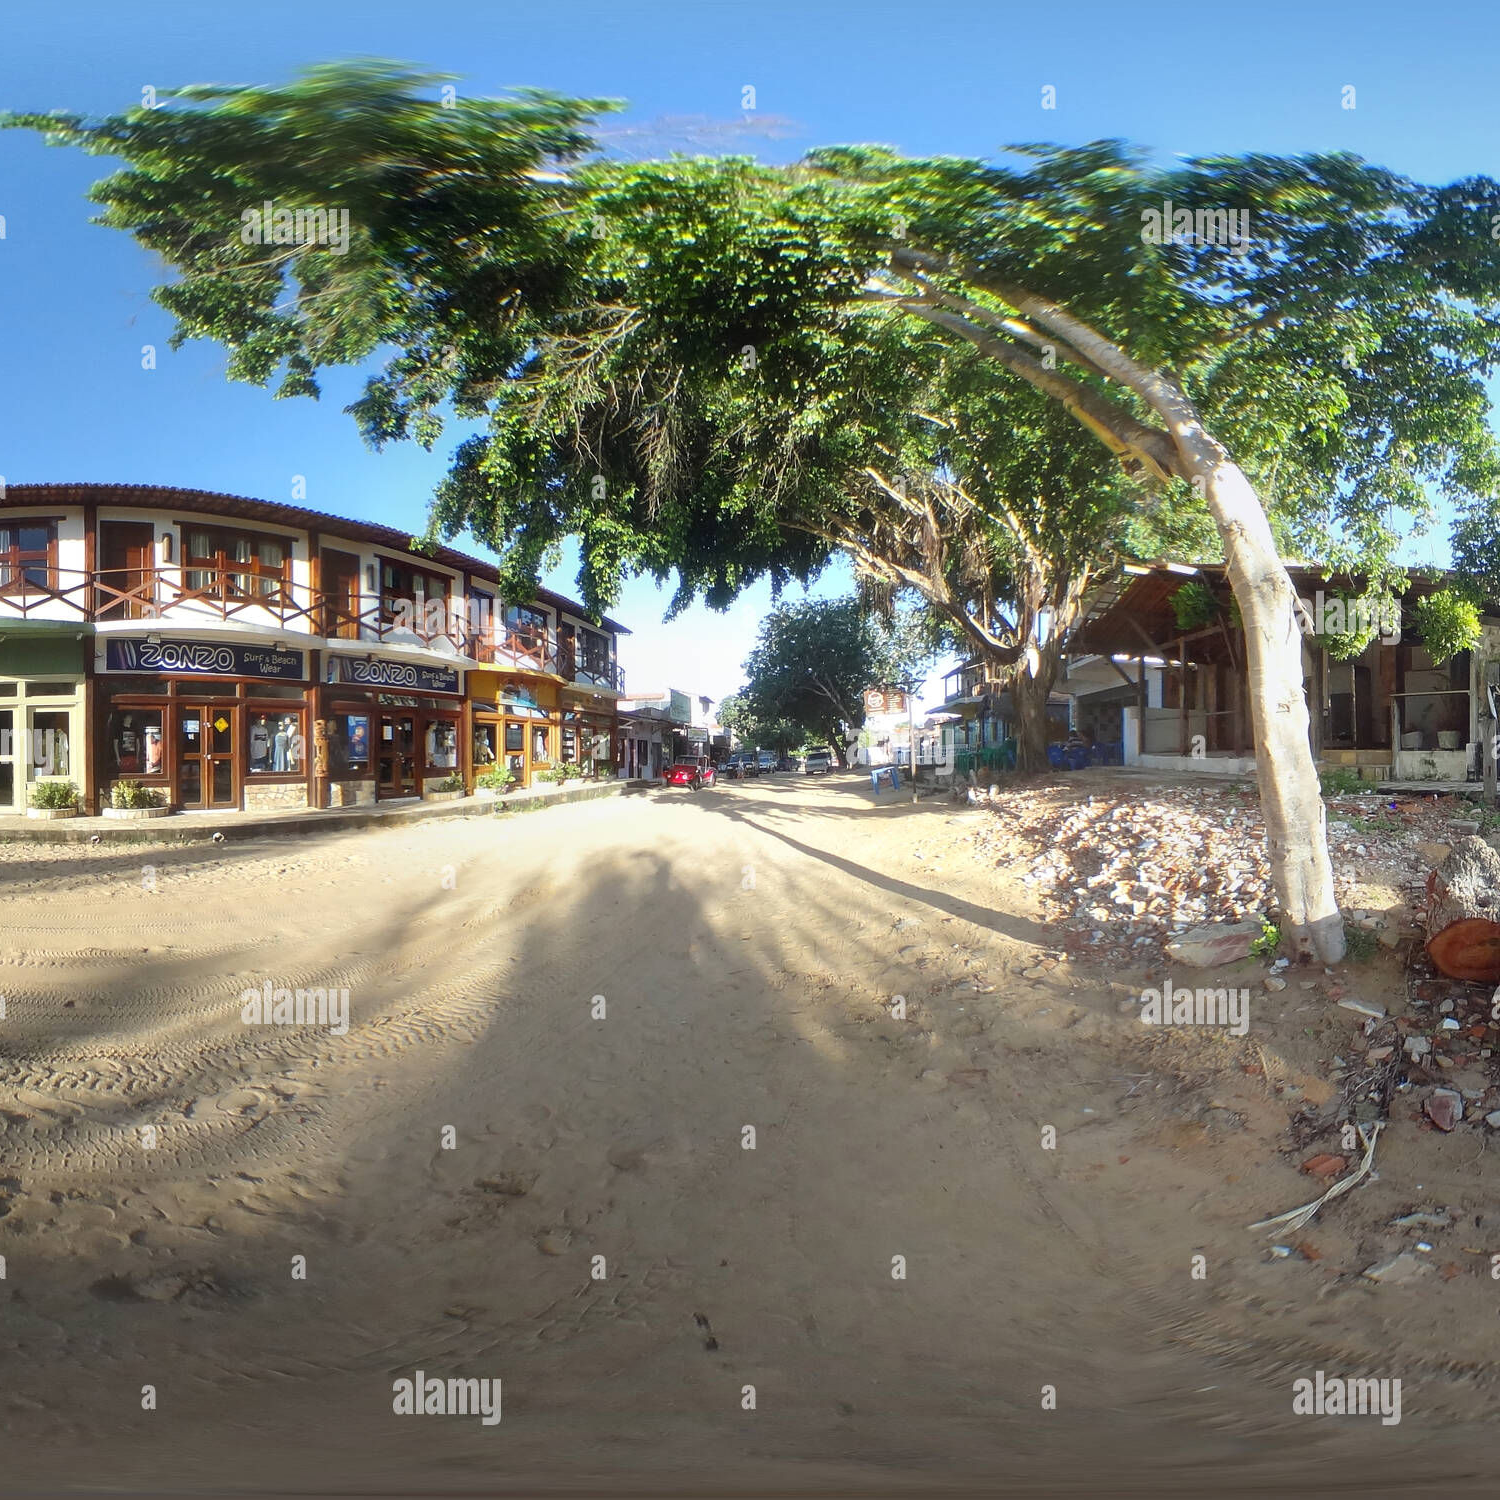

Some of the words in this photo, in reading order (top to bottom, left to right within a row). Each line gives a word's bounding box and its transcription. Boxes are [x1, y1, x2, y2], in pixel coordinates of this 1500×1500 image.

[140, 644, 235, 671] ZONZO
[243, 652, 264, 663] Surf
[271, 654, 297, 665] Beach
[260, 663, 282, 673] Wear
[354, 661, 417, 686] ZONZO
